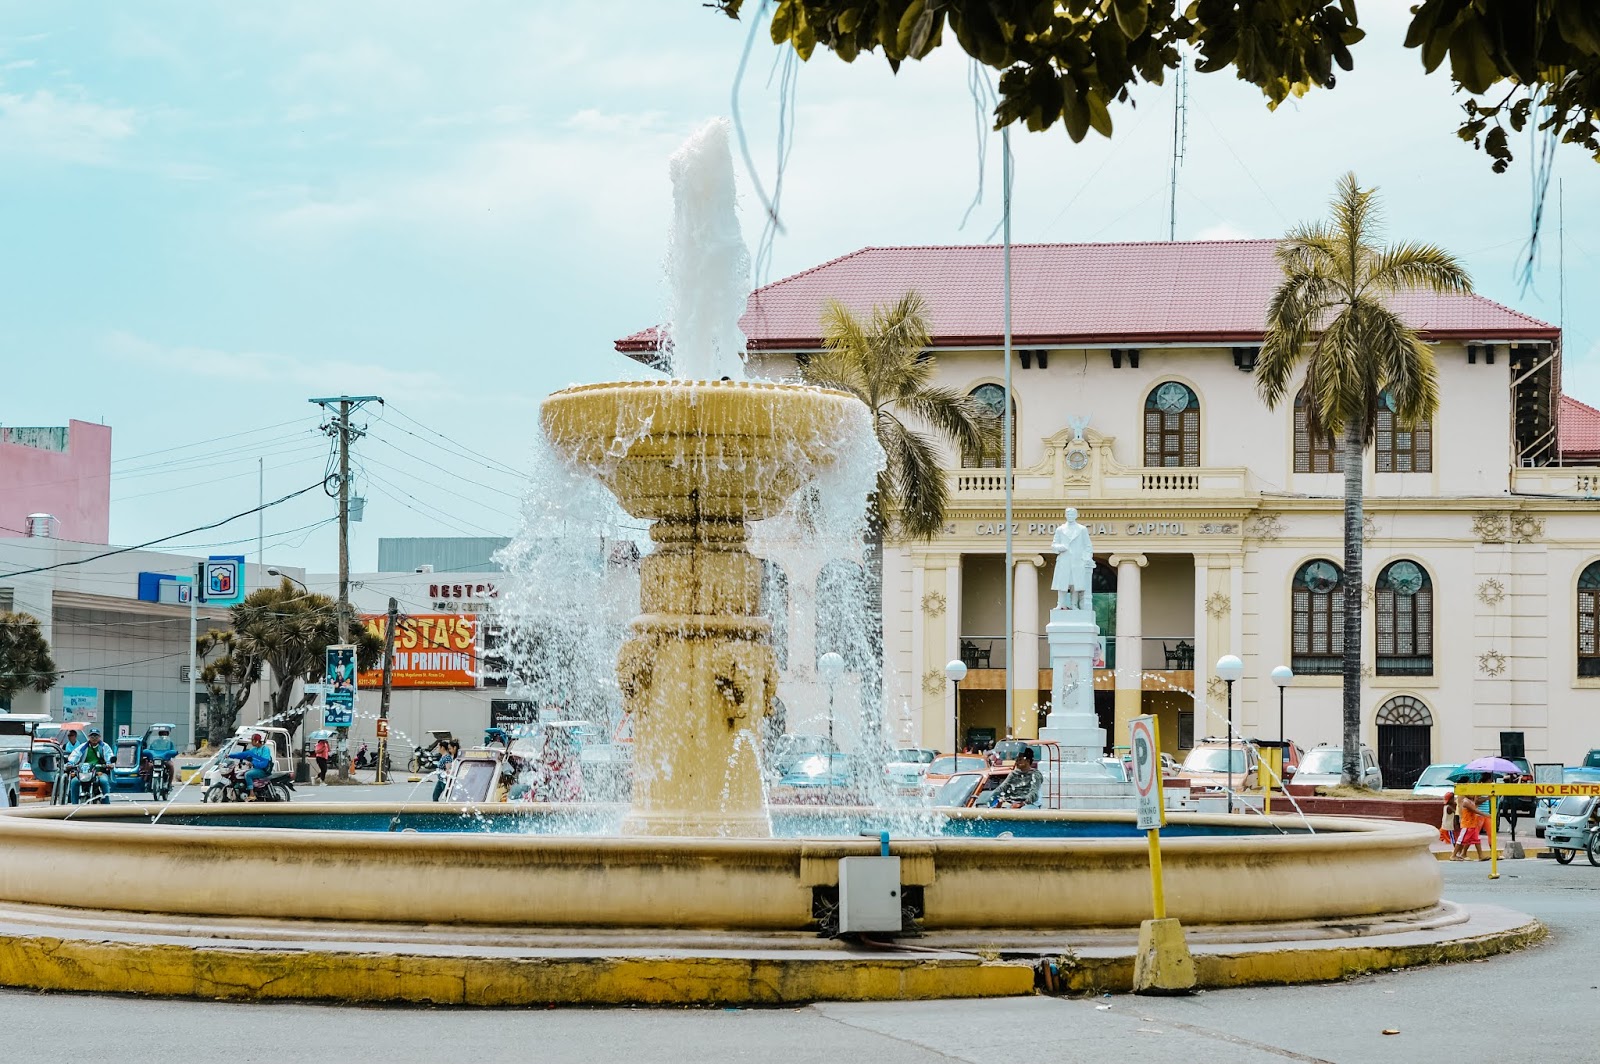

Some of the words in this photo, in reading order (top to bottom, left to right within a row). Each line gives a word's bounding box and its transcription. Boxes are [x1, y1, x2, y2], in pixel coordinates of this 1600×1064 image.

[976, 523, 1019, 536] CAPZ
[1028, 523, 1118, 536] PROCIAL
[1126, 523, 1188, 536] CAPITOL
[412, 652, 470, 670] PRINTING
[1135, 738, 1148, 782] P
[1536, 786, 1555, 794] NO
